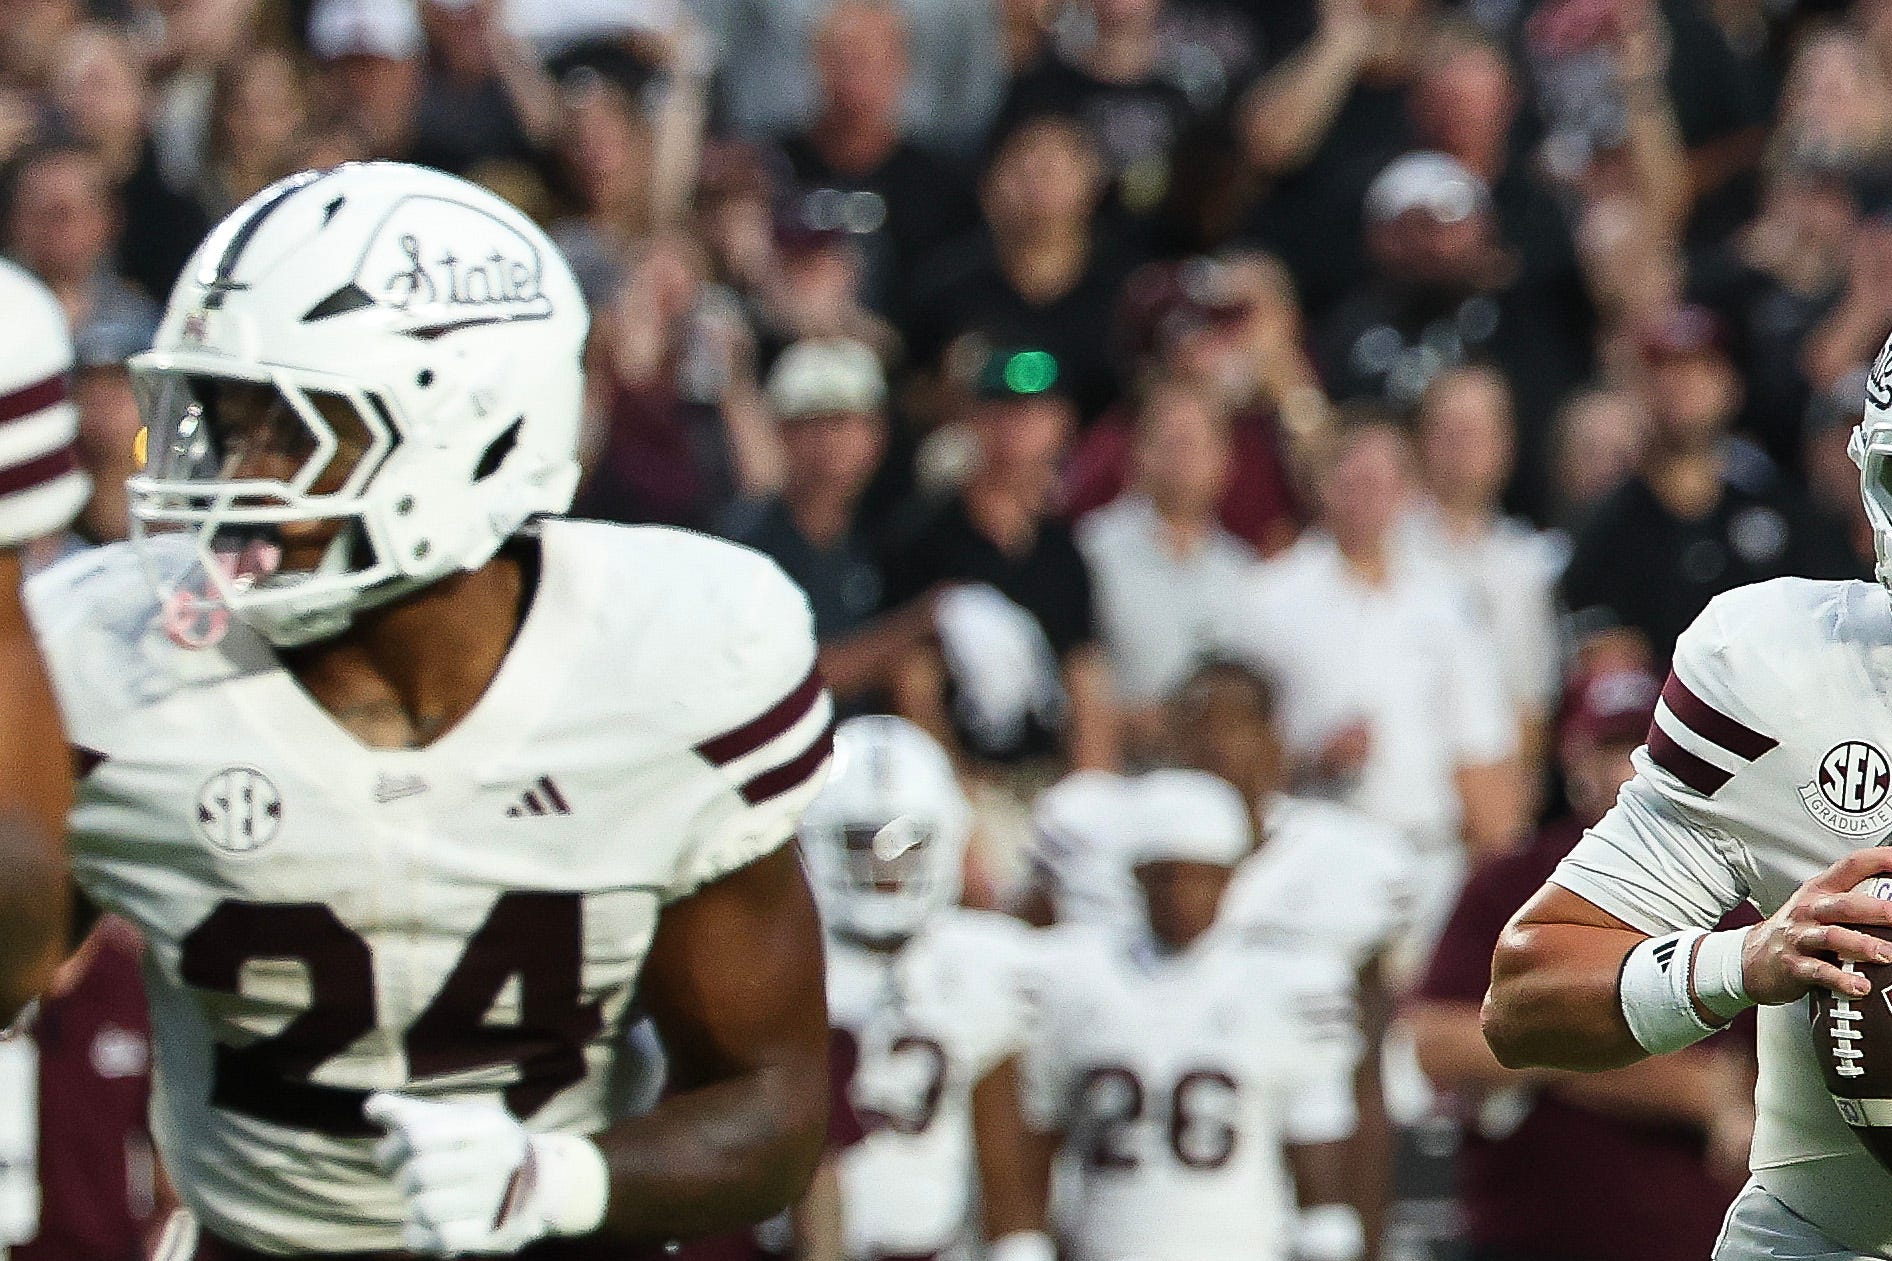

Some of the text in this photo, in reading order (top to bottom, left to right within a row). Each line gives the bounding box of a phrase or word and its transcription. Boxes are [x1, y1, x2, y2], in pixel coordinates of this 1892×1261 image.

[1811, 799, 1890, 833] GRADUATE
[1820, 741, 1889, 812] SEC
[181, 890, 602, 1137] 24
[1074, 1063, 1238, 1170] 26
